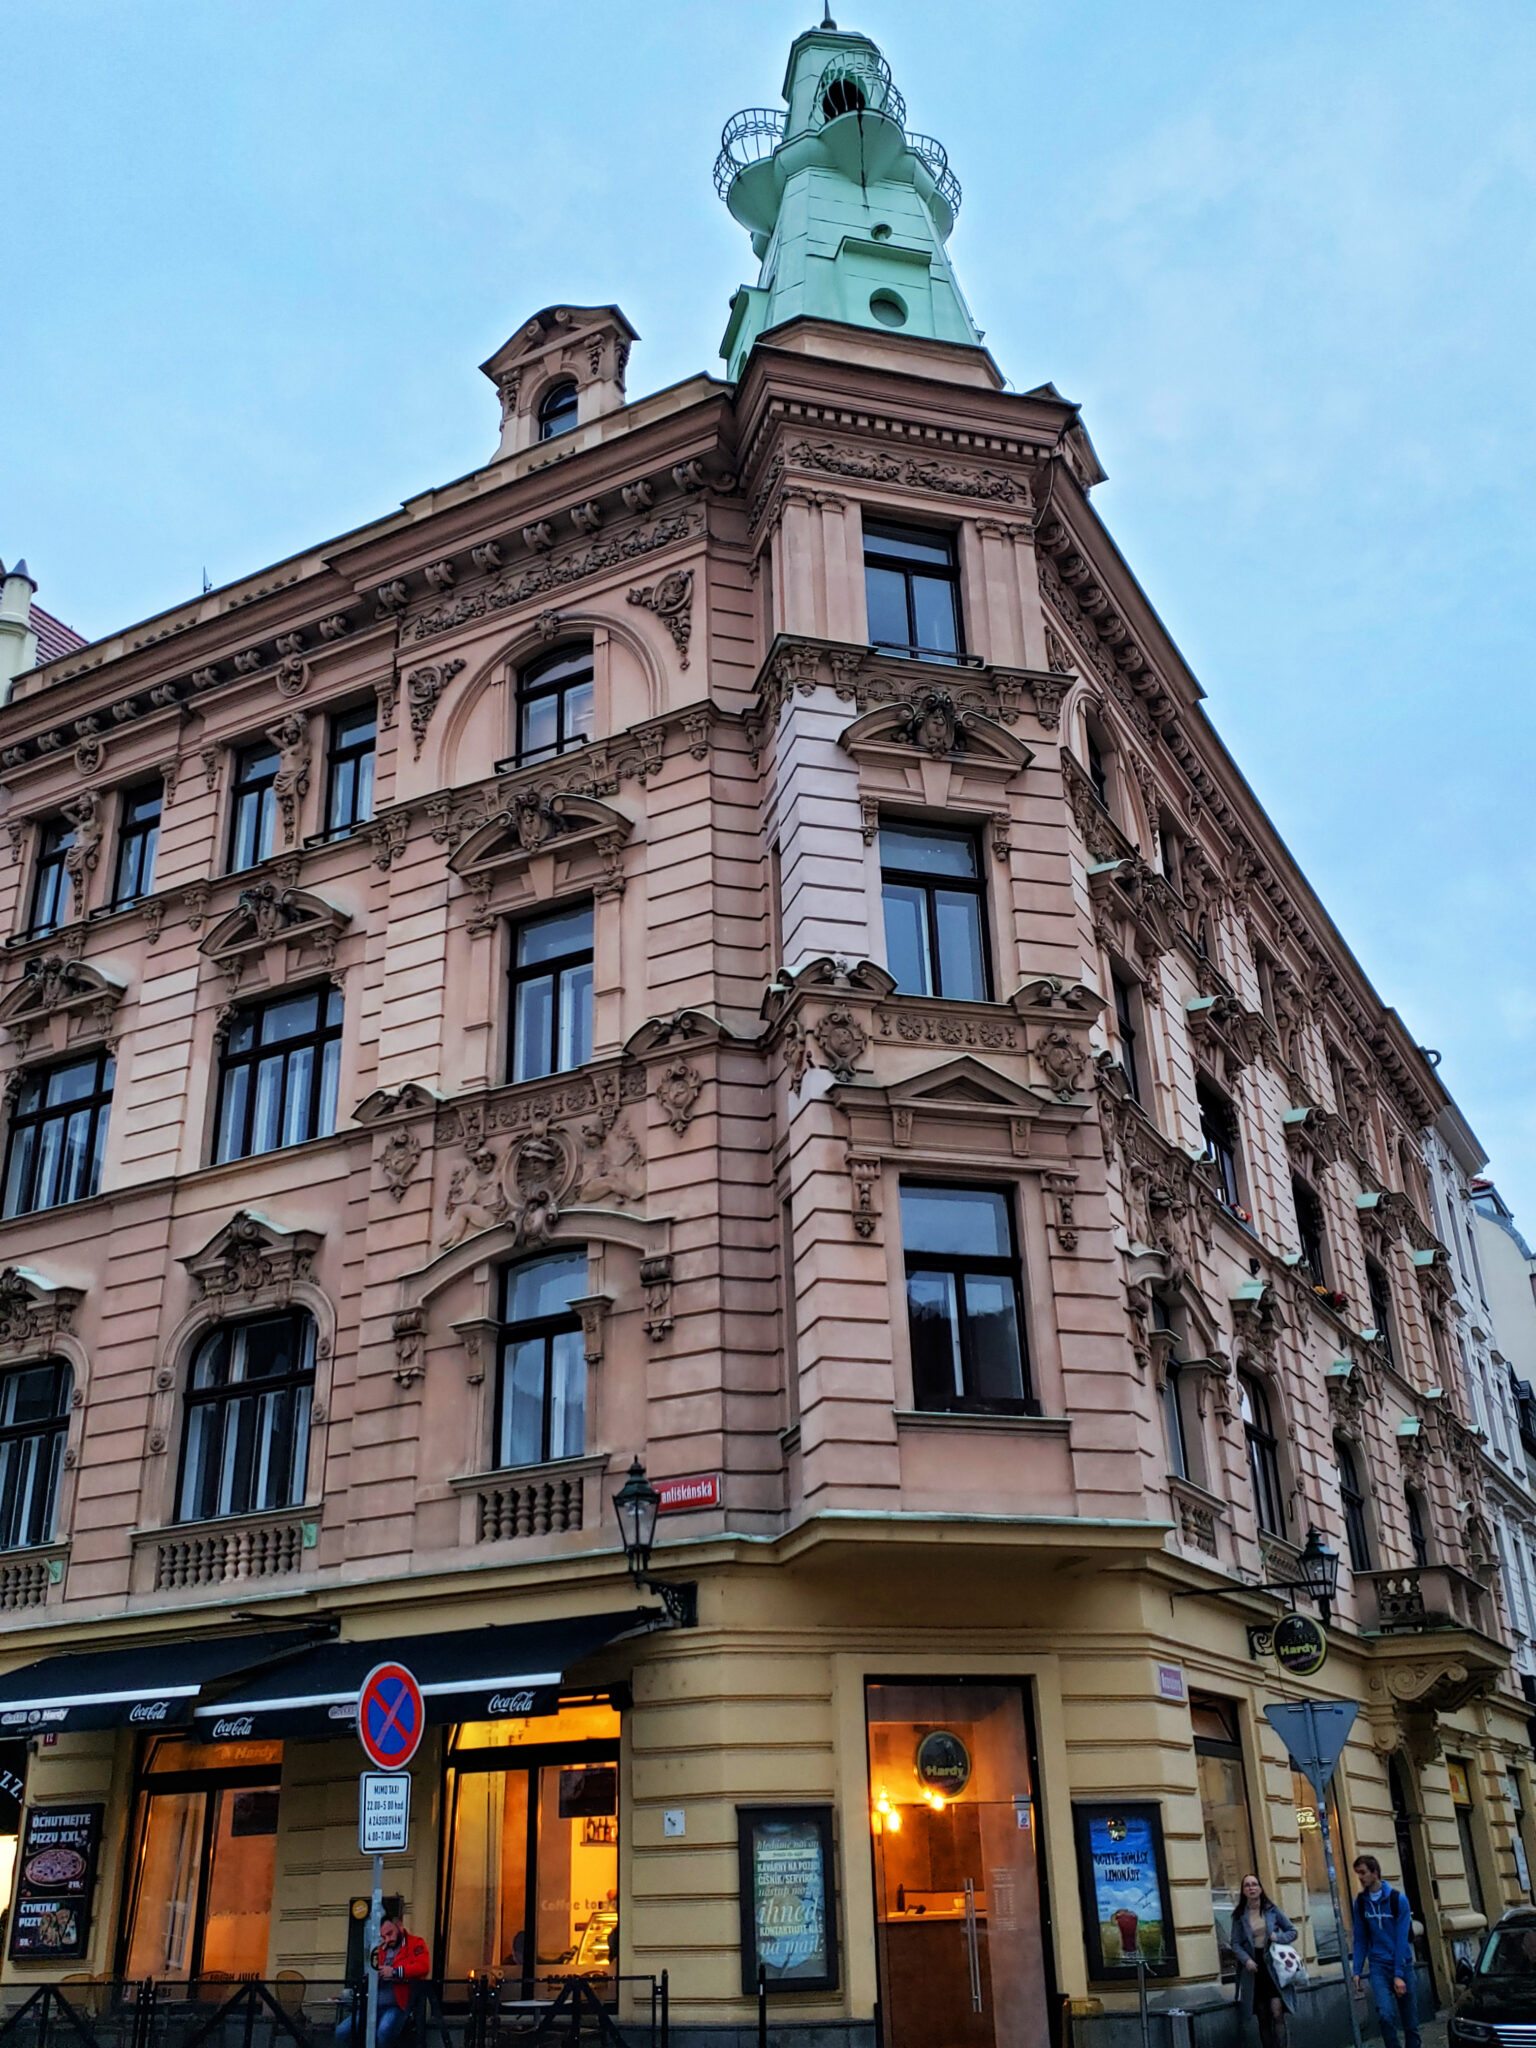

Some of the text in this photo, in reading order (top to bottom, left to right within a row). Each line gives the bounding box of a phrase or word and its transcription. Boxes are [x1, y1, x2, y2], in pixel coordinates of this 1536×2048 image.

[660, 1481, 713, 1504] antiškánská
[1280, 1643, 1317, 1655] Hardy
[926, 1765, 964, 1779] Hardy
[374, 1784, 400, 1795] MIMO TAXI
[30, 1831, 58, 1844] PIZZU
[60, 1830, 80, 1843] XXL
[788, 1861, 798, 1872] NA
[19, 1917, 42, 1928] PIZZY
